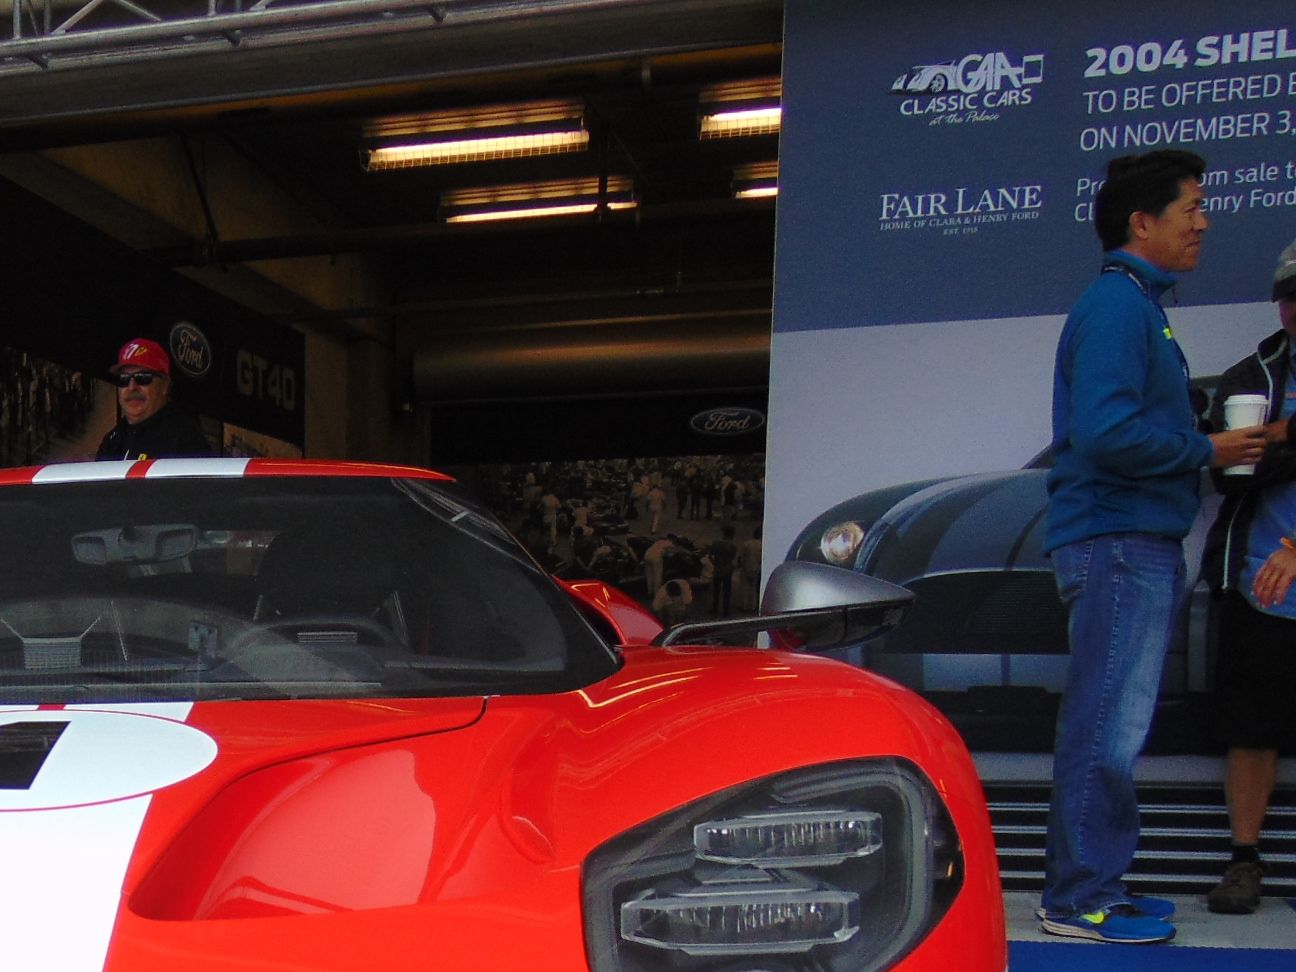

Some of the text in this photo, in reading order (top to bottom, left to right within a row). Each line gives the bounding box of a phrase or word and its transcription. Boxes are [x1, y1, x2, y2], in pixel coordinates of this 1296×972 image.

[1083, 28, 1296, 78] 2004 SHEL
[900, 88, 1032, 115] CLASSIC CARS
[1082, 89, 1117, 115] TO
[1123, 85, 1156, 111] BE
[1161, 74, 1281, 108] OFFERED
[1080, 125, 1117, 151] ON
[1124, 112, 1271, 148] NOVEMBER
[1234, 161, 1279, 185] sale
[879, 193, 949, 220] FAIR
[954, 185, 1042, 215] LANE
[1199, 188, 1296, 214] enry Ford
[880, 221, 911, 231] HOME
[913, 219, 927, 228] OF
[929, 217, 962, 227] CLARA
[973, 213, 1009, 224] HENRY
[1011, 211, 1039, 221] FORD
[177, 328, 204, 368] Ford
[236, 348, 297, 412] GT40
[704, 410, 752, 430] Ford
